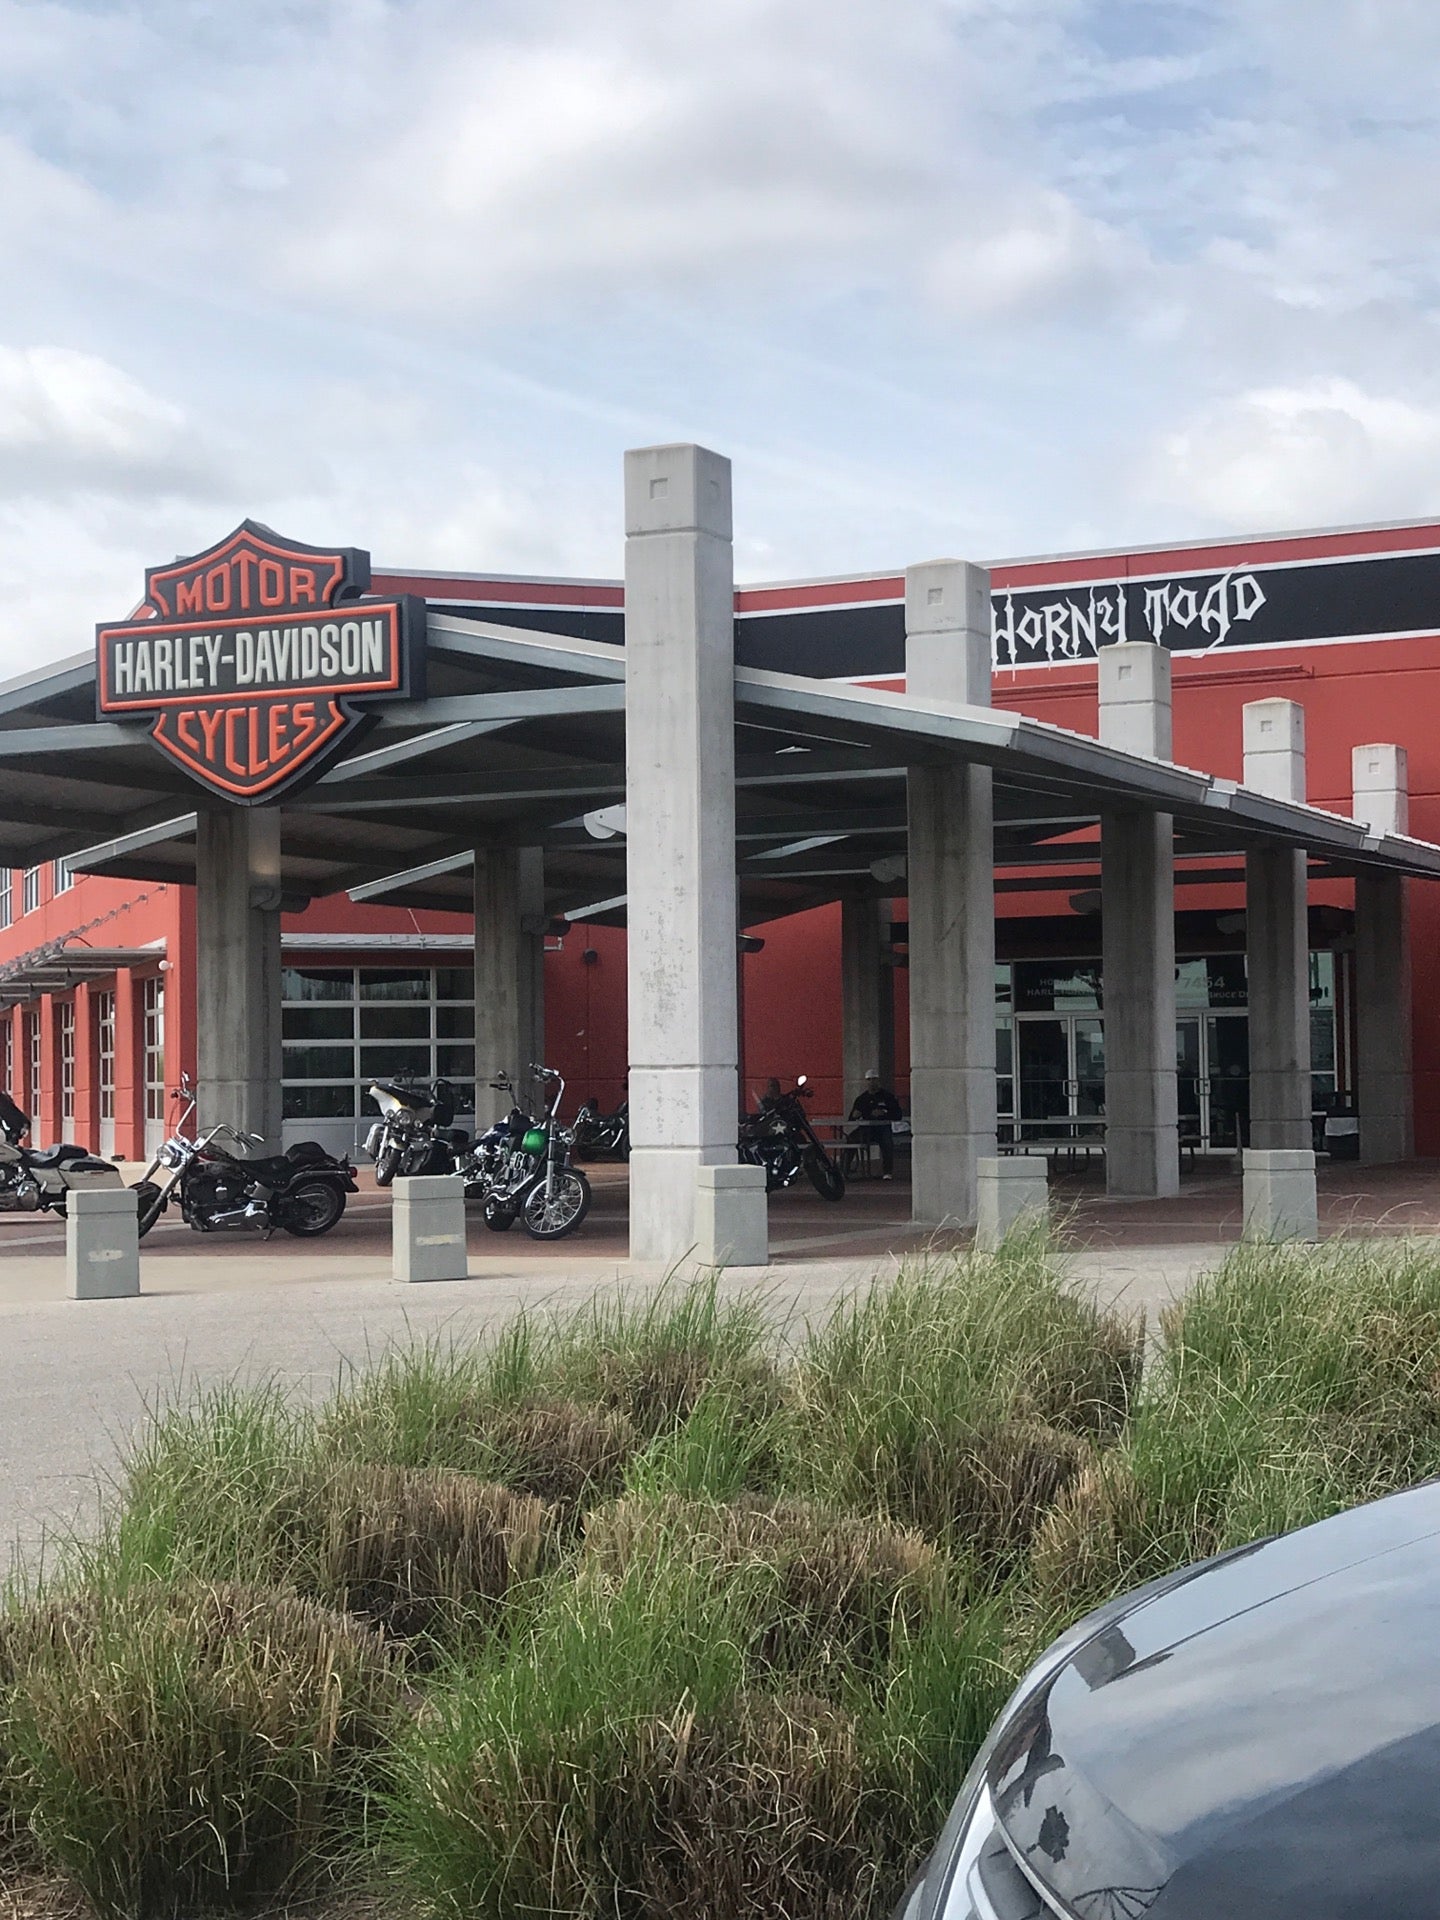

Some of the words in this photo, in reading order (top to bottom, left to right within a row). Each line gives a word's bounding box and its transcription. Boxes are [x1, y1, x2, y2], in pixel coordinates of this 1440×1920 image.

[176, 549, 316, 616] MOTOR
[1142, 562, 1267, 659] TOAD
[114, 620, 384, 695] HARLEY-DAVIDSON
[177, 701, 316, 777] CYCLES
